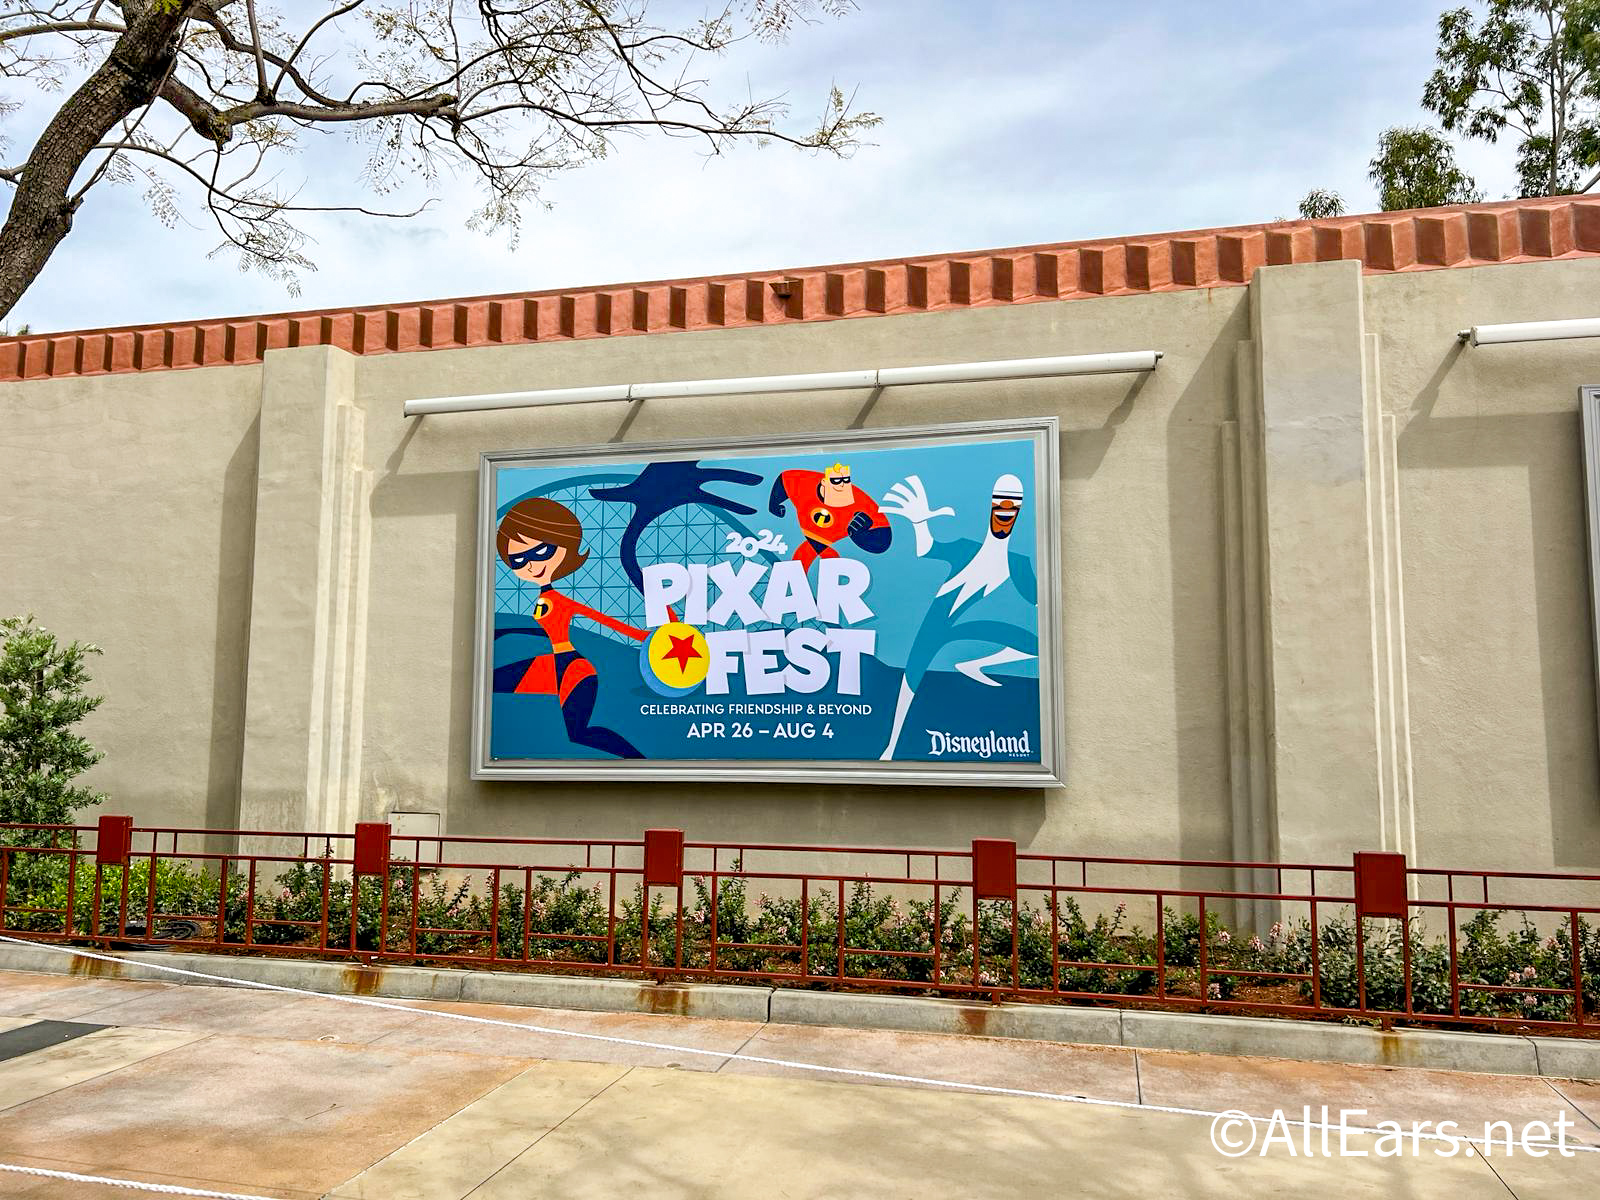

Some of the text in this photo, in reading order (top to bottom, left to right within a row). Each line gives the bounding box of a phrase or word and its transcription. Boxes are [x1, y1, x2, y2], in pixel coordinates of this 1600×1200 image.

[725, 529, 788, 557] 2024
[642, 558, 875, 626] PIXAR
[704, 628, 877, 695] FEST
[640, 704, 872, 715] CELEBRATING FRIENDSHIP & BEYOND
[686, 723, 725, 738] APR
[731, 722, 753, 738] 26
[773, 722, 816, 738] AUG
[822, 722, 834, 738] 4
[926, 729, 1031, 759] Disneyland
